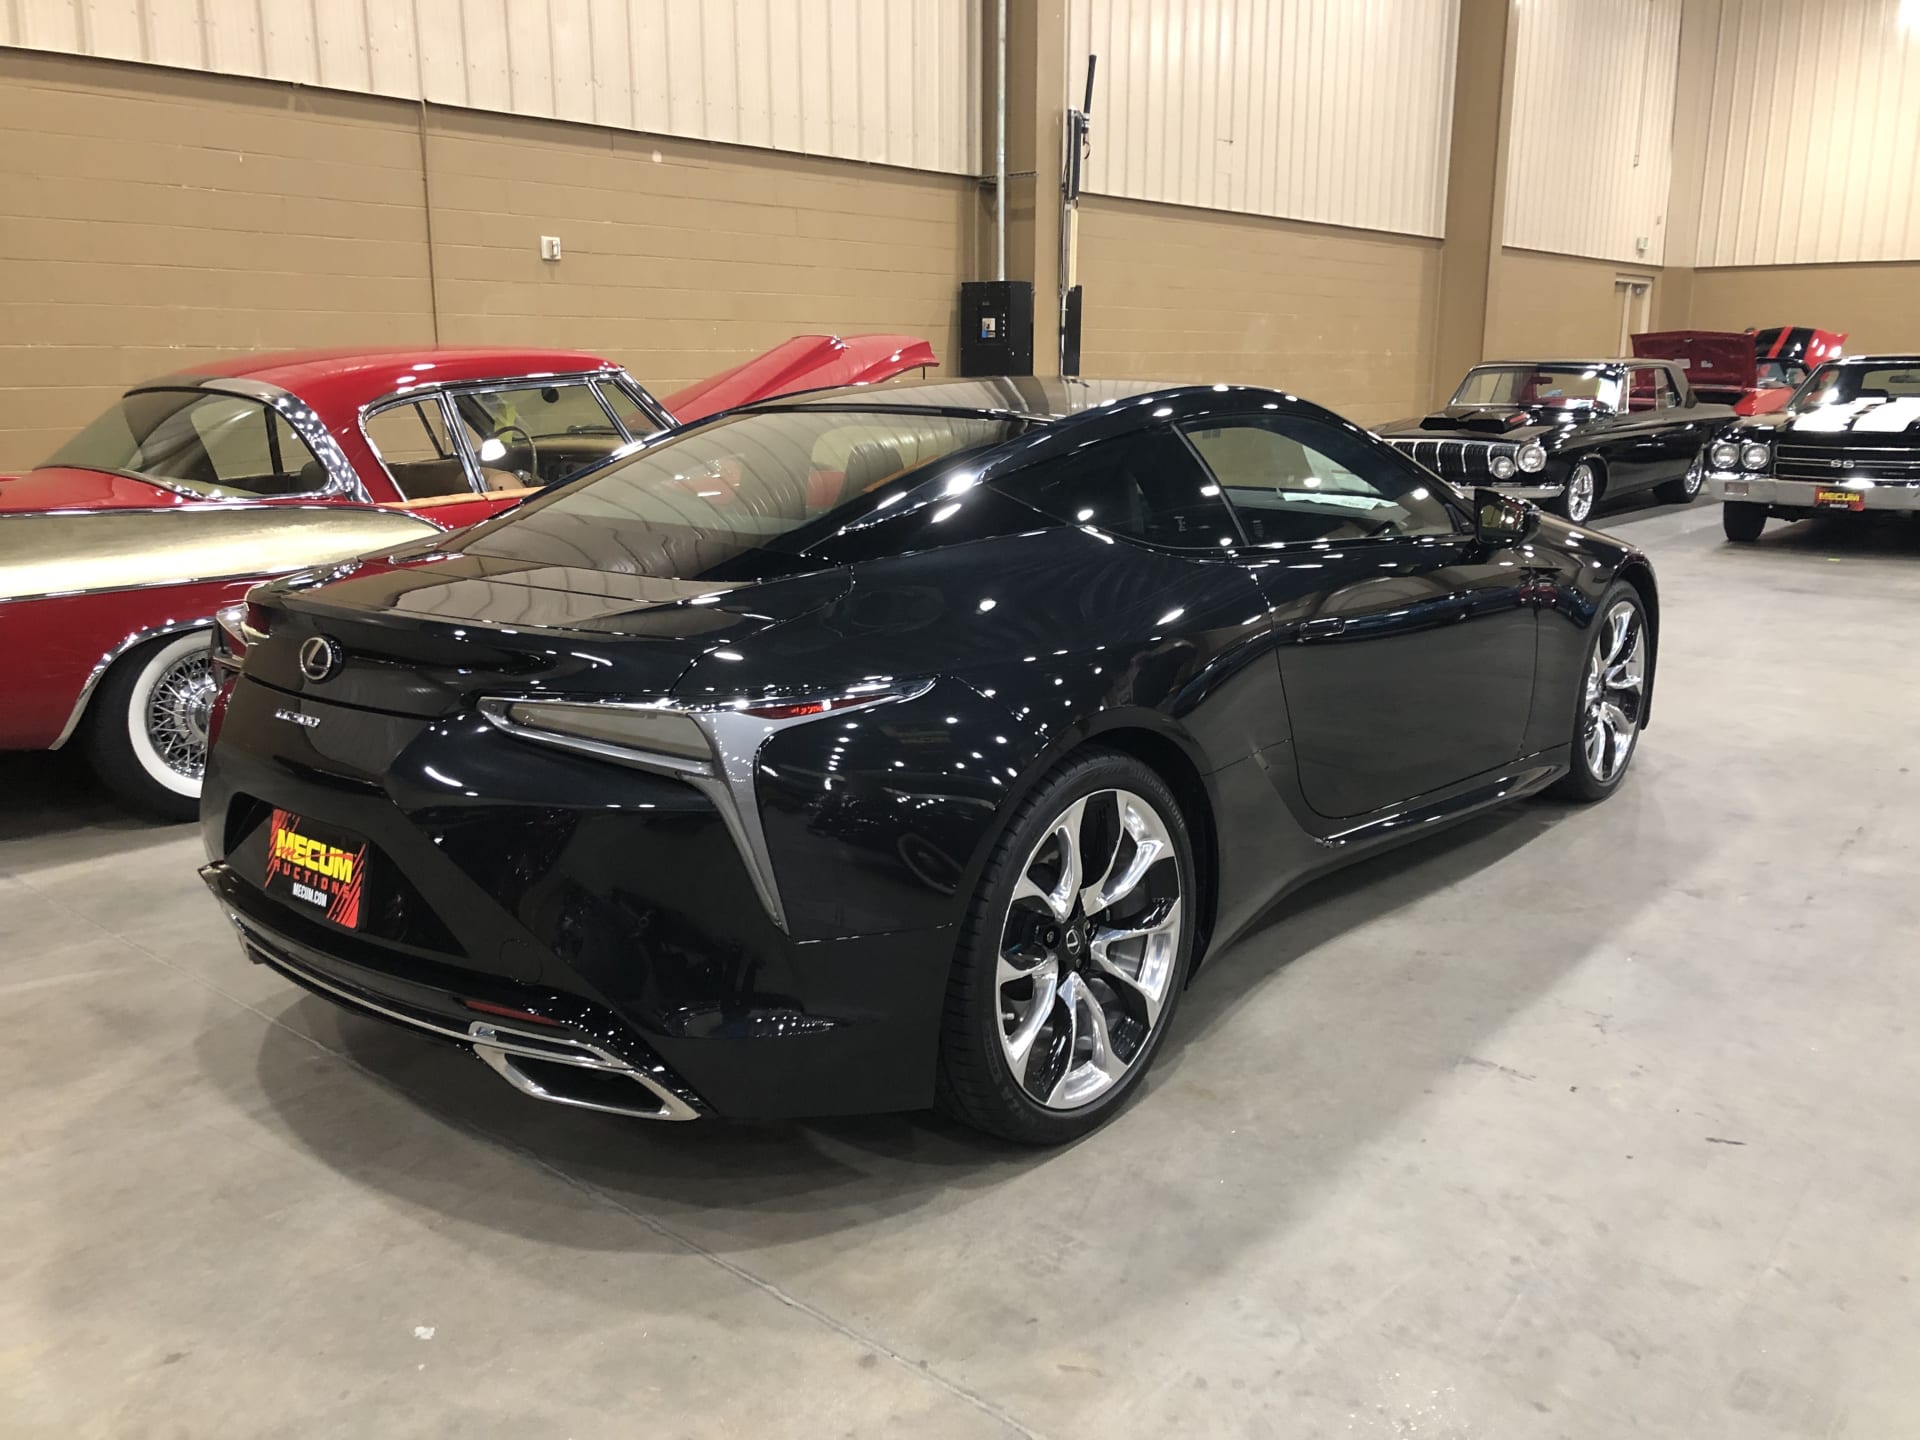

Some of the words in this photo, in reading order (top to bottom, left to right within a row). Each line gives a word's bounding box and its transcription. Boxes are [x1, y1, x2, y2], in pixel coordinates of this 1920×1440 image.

[1818, 491, 1860, 502] MECUM
[275, 828, 354, 884] MECUM
[272, 857, 351, 900] AUCTIONS
[292, 882, 328, 908] MECUM.COM
